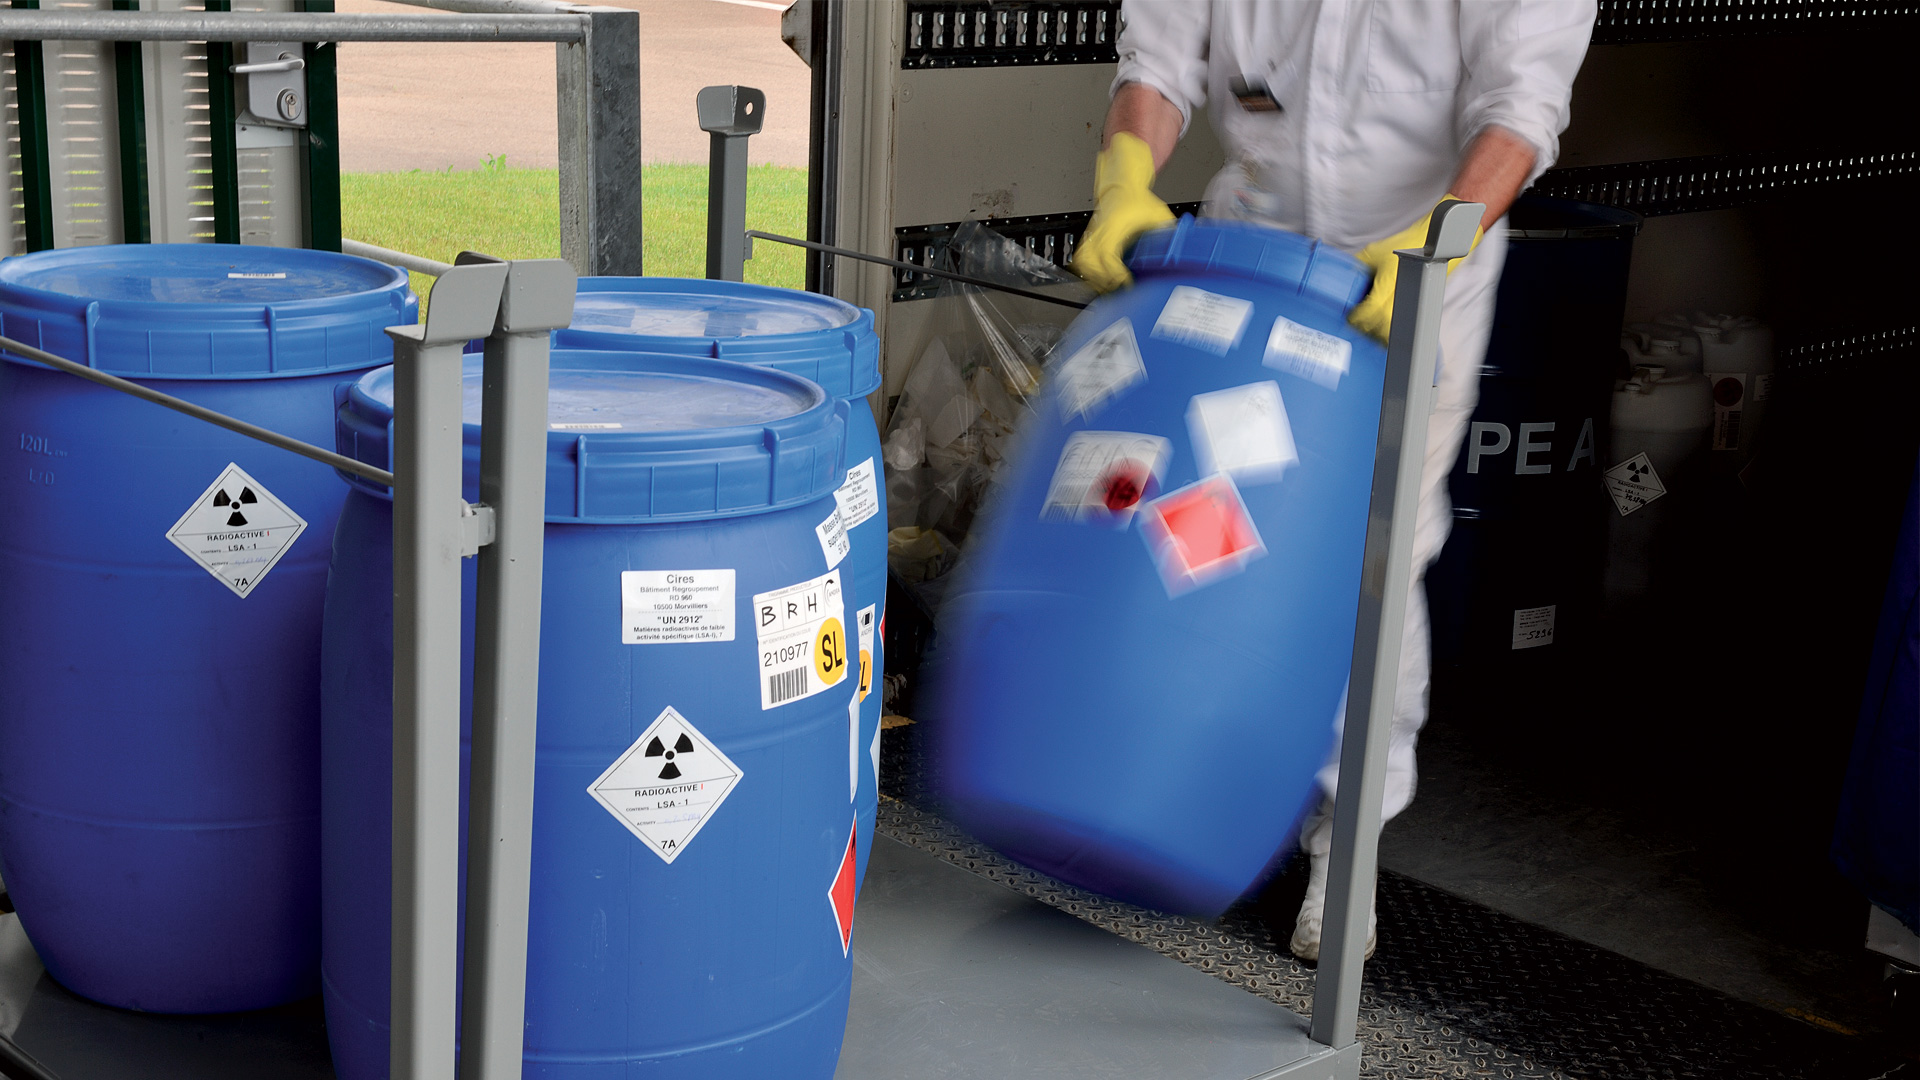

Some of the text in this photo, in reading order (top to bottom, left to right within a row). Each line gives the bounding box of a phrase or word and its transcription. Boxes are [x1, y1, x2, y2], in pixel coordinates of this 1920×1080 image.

[1566, 417, 1596, 472] A
[207, 531, 264, 541] RADIOACTIVE
[228, 544, 245, 552] LSA
[234, 577, 249, 586] 7A
[666, 574, 695, 584] Cires
[762, 593, 817, 627] B R H
[764, 641, 808, 667] 210977
[822, 631, 843, 672] SL
[859, 661, 867, 691] L
[634, 784, 698, 797] RADIOACTIVE
[657, 801, 676, 809] LSA
[685, 798, 689, 806] 1
[661, 839, 676, 849] 7A
